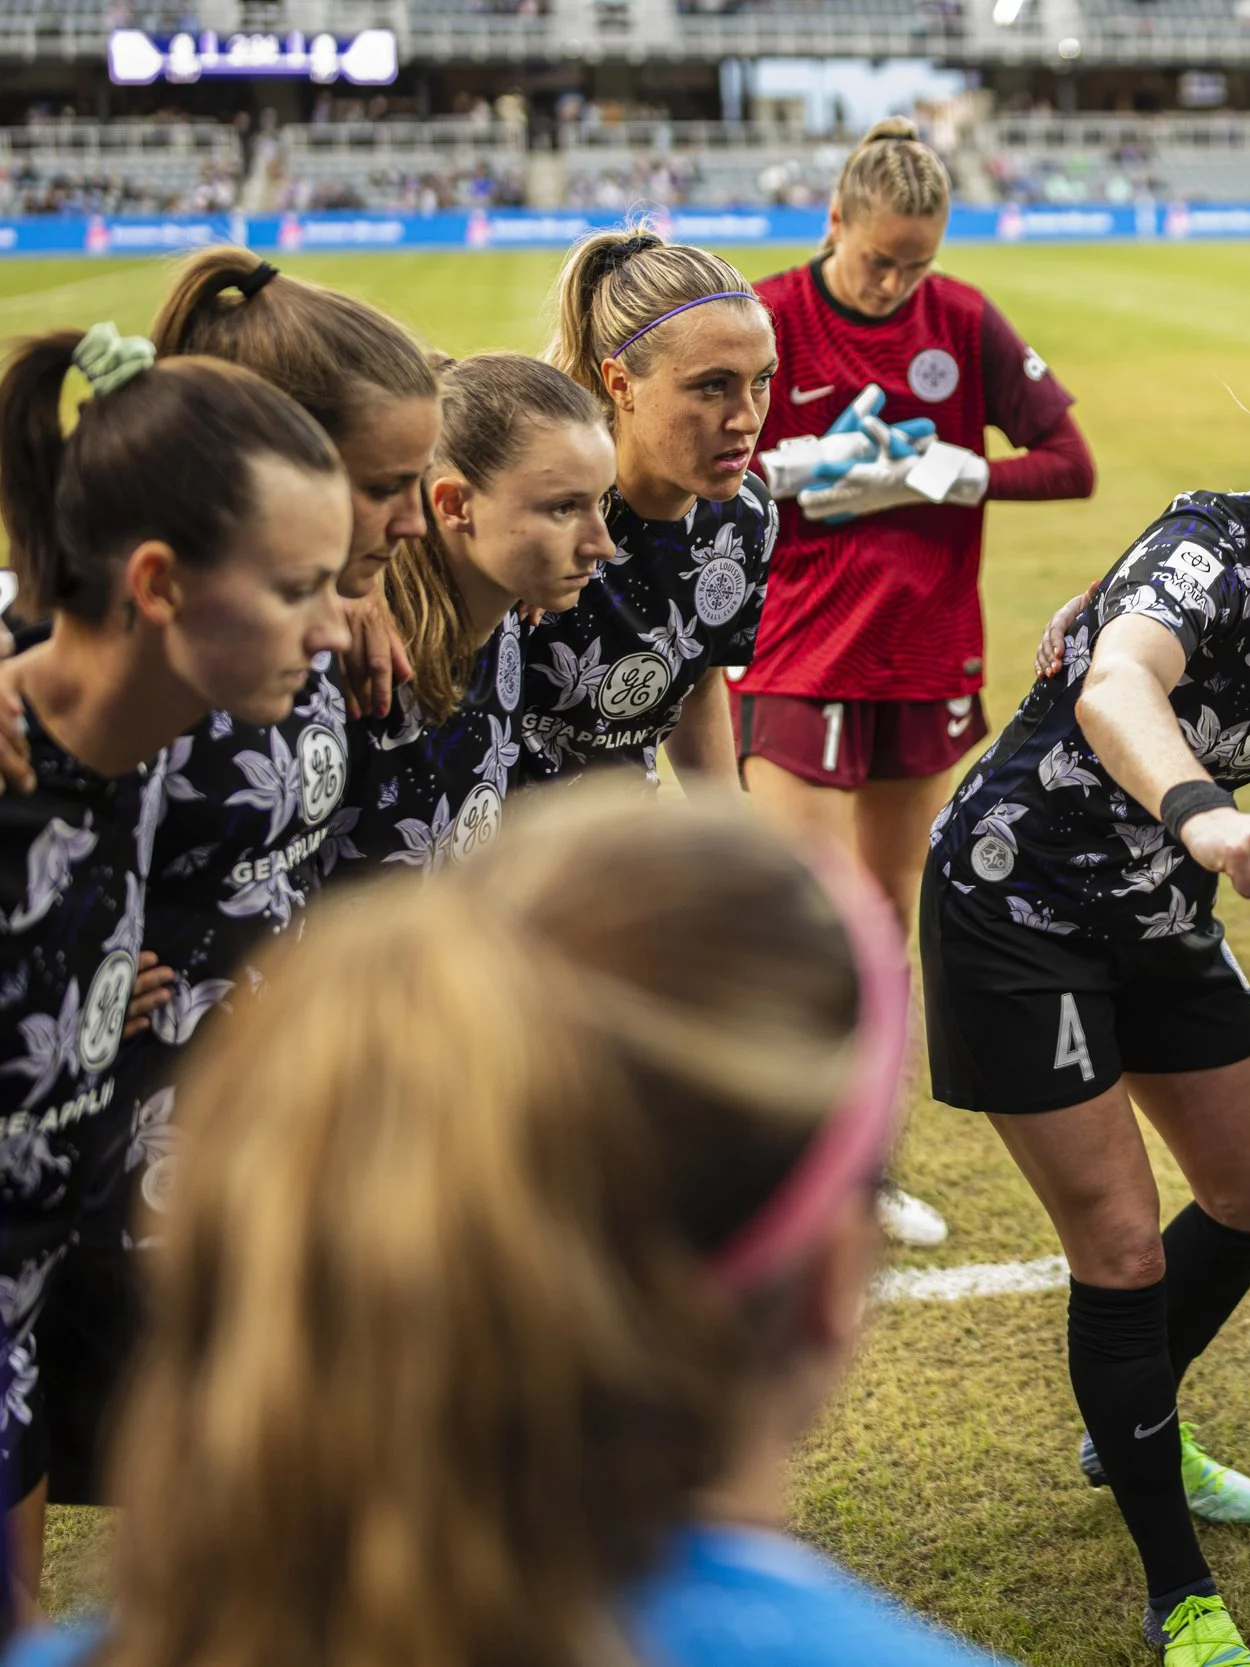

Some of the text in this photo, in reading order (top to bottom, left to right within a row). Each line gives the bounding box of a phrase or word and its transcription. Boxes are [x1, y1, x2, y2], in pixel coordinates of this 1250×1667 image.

[699, 562, 743, 596] RACING LOUISVILLE
[1151, 572, 1208, 611] TOYOTA
[723, 600, 737, 616] CLUB
[522, 712, 554, 732] GE
[822, 702, 844, 771] 1
[232, 857, 271, 883] GE
[1053, 992, 1095, 1081] 4
